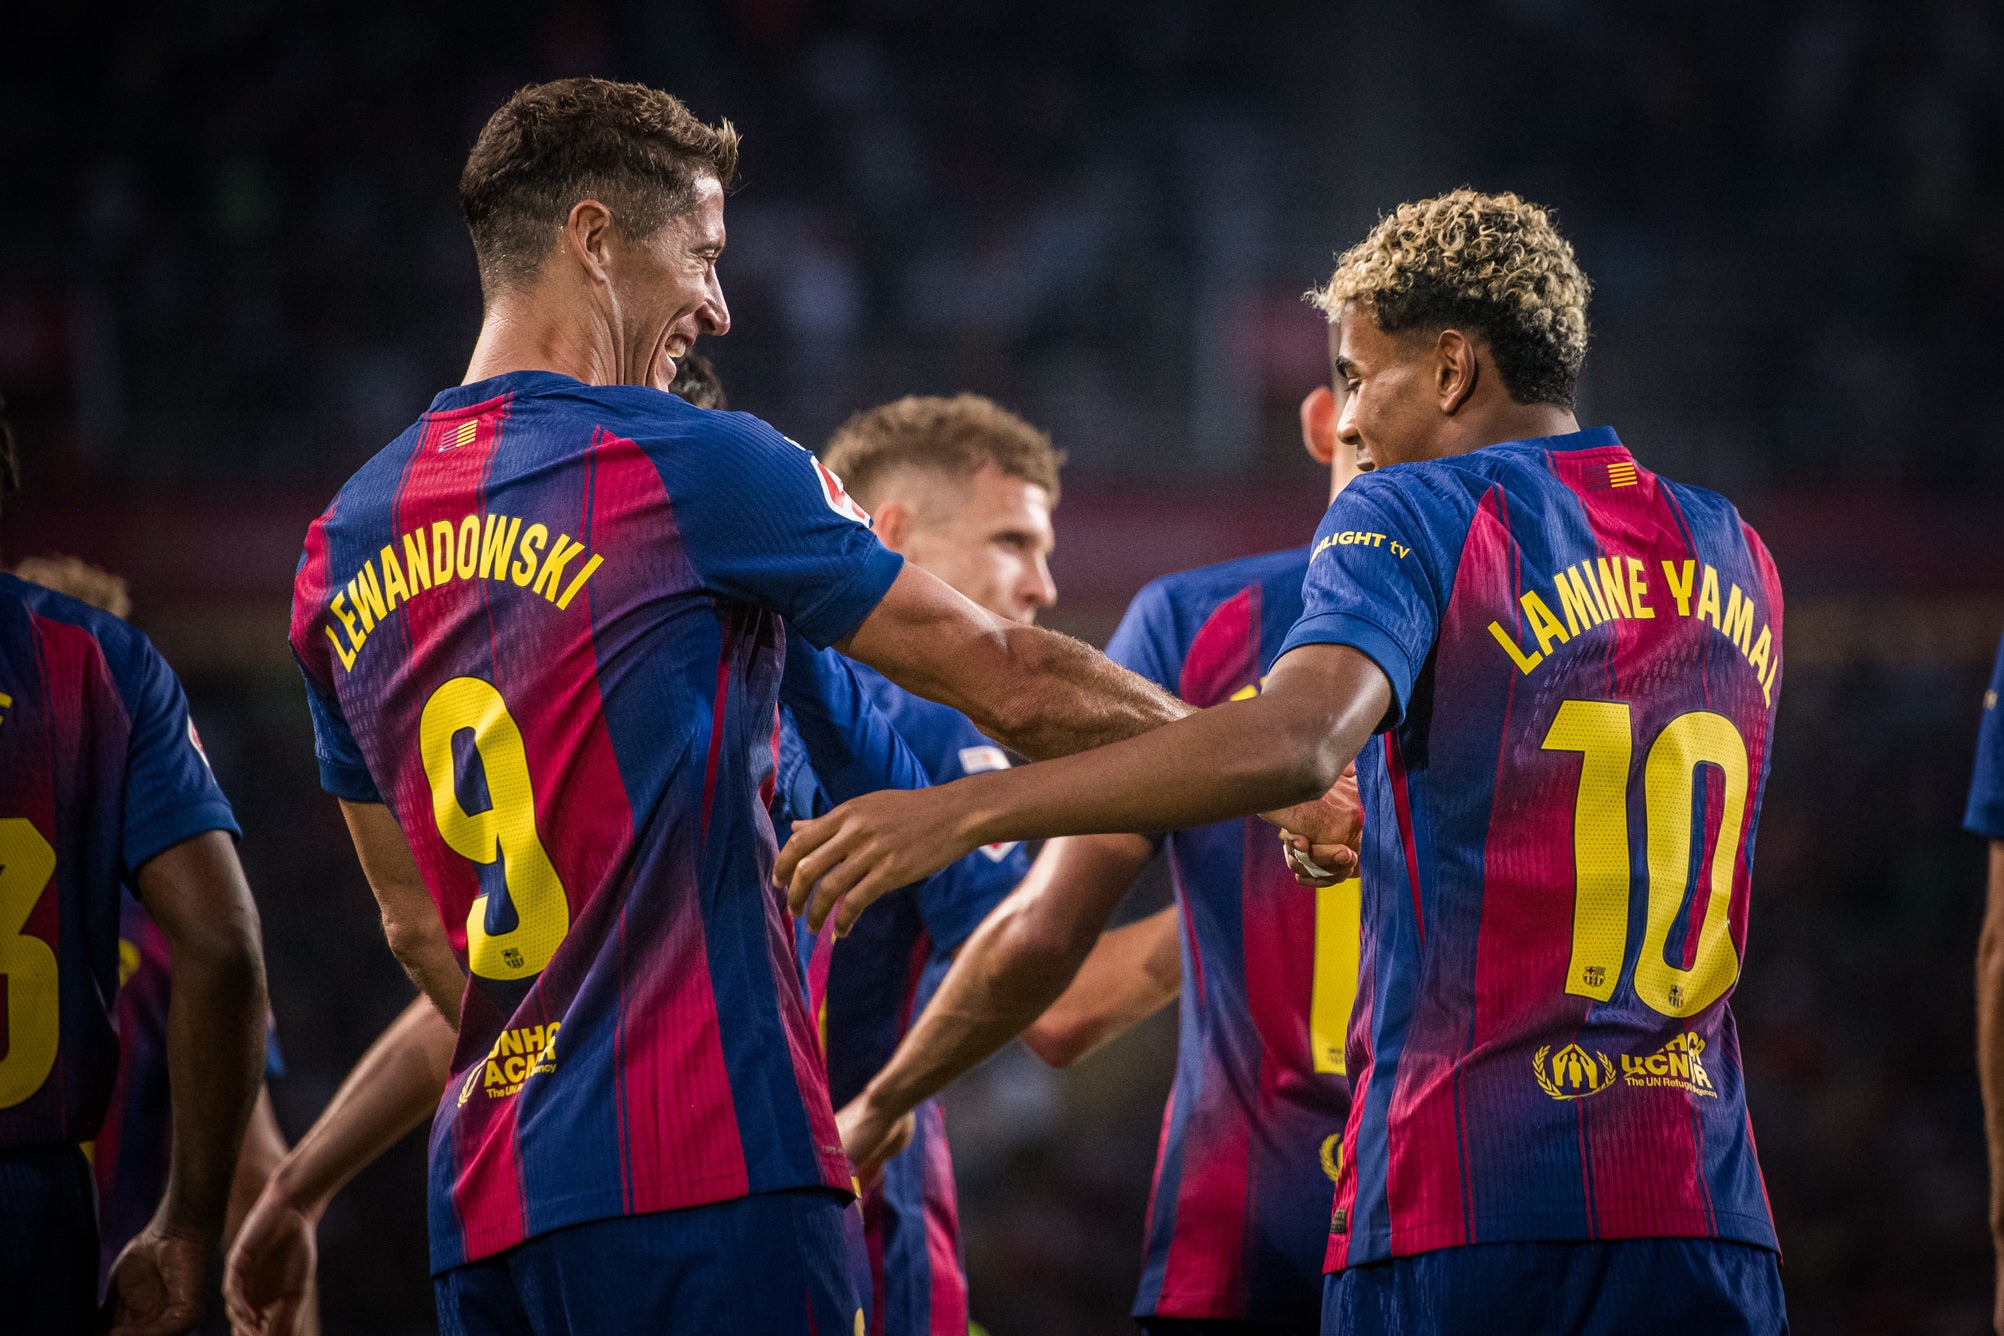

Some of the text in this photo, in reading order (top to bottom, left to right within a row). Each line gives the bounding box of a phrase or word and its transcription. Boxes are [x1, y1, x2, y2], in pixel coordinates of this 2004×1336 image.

[325, 514, 605, 673] LEWANDOWSKI
[1390, 540, 1411, 559] tv
[1487, 556, 1778, 709] LAMINE YAMAL
[419, 676, 570, 981] 9
[1541, 700, 1749, 1018] 10
[1624, 1077, 1645, 1087] The
[1646, 1077, 1662, 1087] UN
